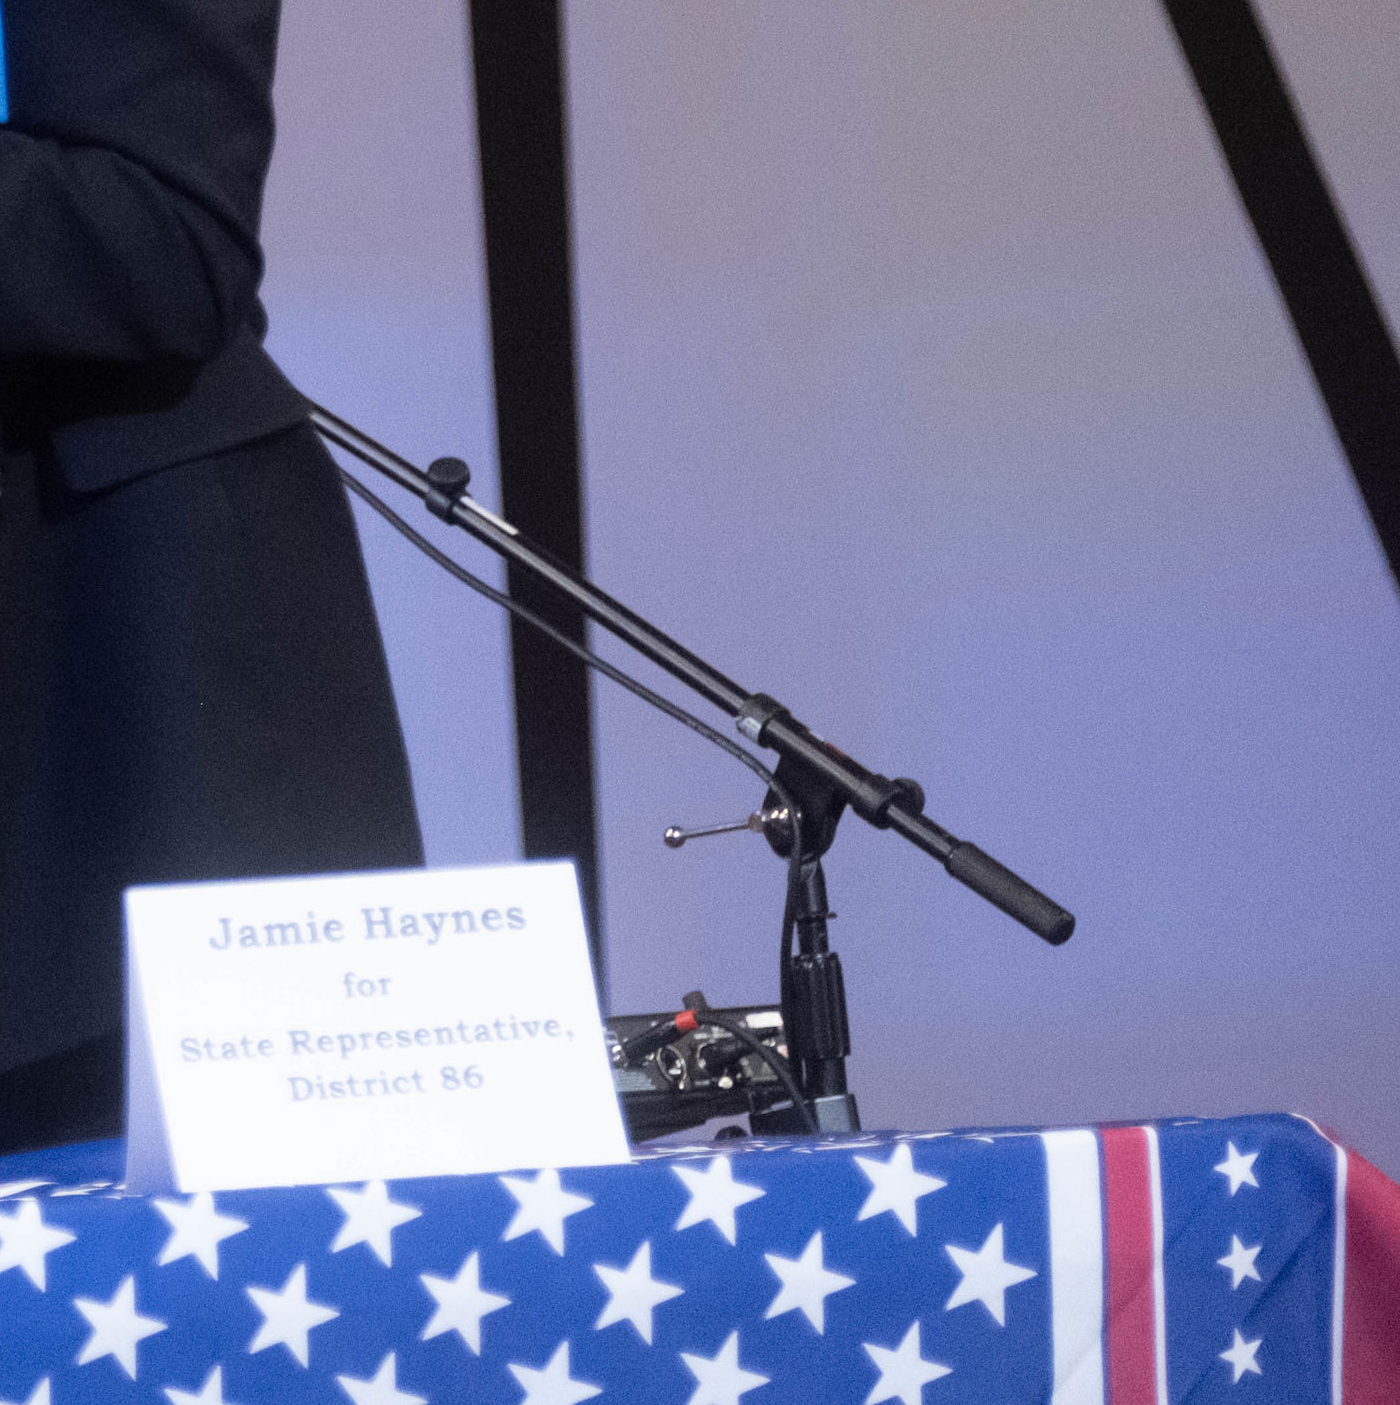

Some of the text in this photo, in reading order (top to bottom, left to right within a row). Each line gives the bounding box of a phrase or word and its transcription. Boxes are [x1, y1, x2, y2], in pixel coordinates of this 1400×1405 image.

[208, 905, 527, 951] Jamie Haynes
[342, 970, 392, 999] for
[179, 1014, 575, 1063] State Representative,
[286, 1064, 484, 1103] District 86
